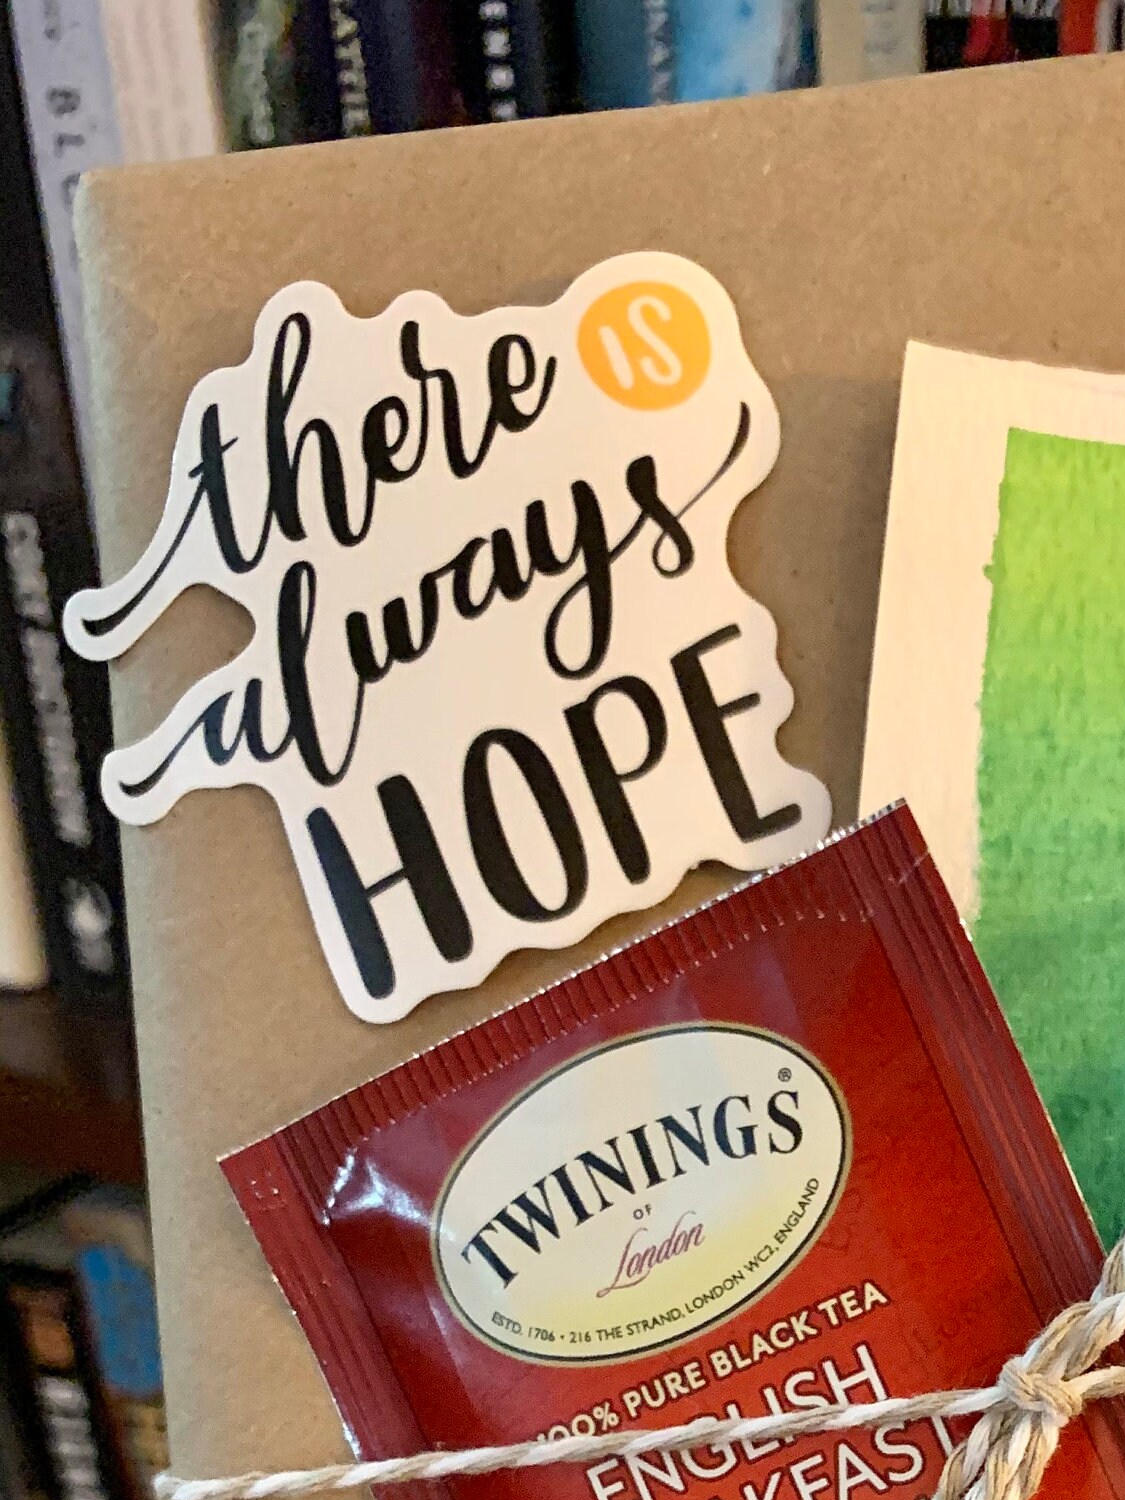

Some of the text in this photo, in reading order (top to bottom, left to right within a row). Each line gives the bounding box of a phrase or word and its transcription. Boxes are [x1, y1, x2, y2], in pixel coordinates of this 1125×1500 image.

[83, 313, 556, 635] there
[119, 402, 750, 796] always
[306, 624, 802, 999] HOPE
[491, 1311, 523, 1336] ESTD.
[528, 1327, 555, 1342] 1706
[569, 1332, 592, 1343] 216
[596, 1328, 623, 1342] THE
[684, 1270, 745, 1314] LONDON
[774, 1177, 820, 1245] ENGLAND
[596, 1211, 705, 1298] London
[633, 1205, 652, 1220] OF
[623, 1362, 706, 1417] PURE
[709, 1310, 817, 1378] BLACK
[818, 1282, 888, 1326] TEA
